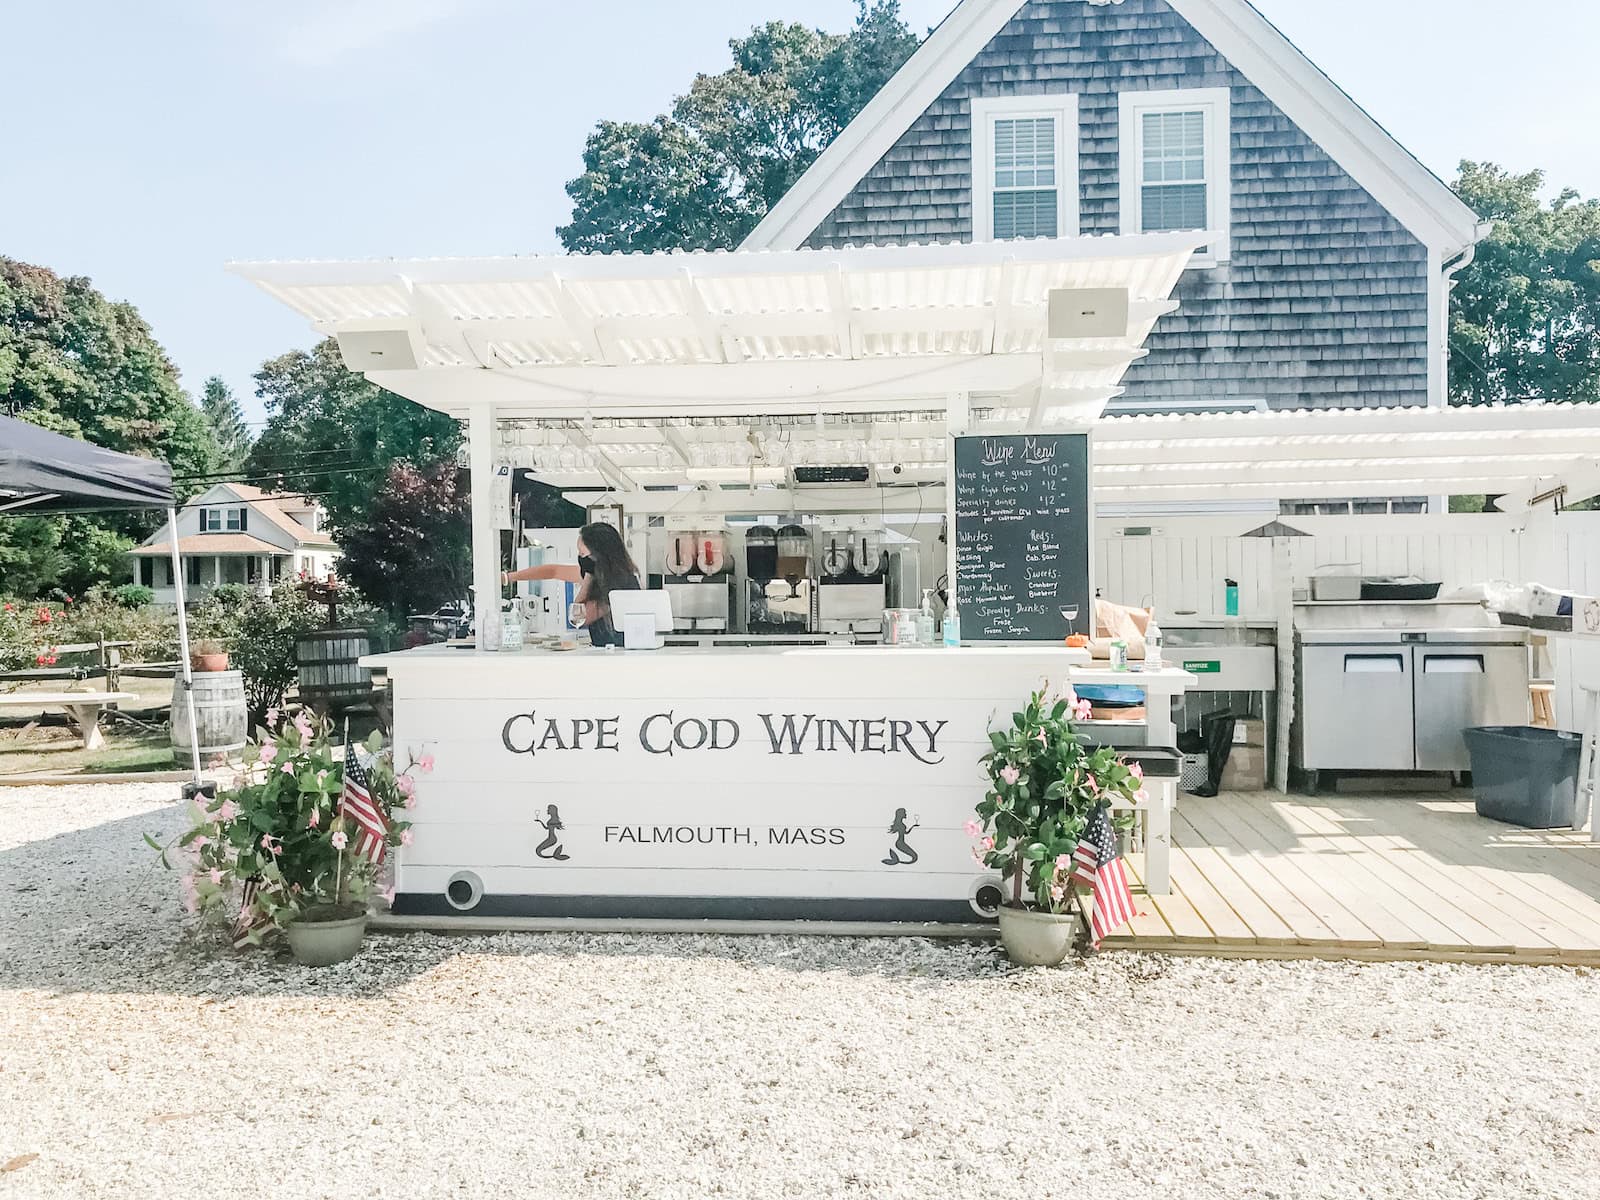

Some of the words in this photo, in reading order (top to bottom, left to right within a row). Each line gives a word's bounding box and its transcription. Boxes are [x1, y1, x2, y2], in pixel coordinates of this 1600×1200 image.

[982, 439, 1014, 465] Wine
[1020, 437, 1057, 459] Menu
[957, 467, 976, 481] Wine
[983, 470, 990, 482] by
[995, 470, 1005, 478] the
[1012, 470, 1032, 480] glass
[957, 484, 975, 494] Wine
[604, 825, 758, 848] FALMOUTH,
[768, 826, 846, 846] MASS
